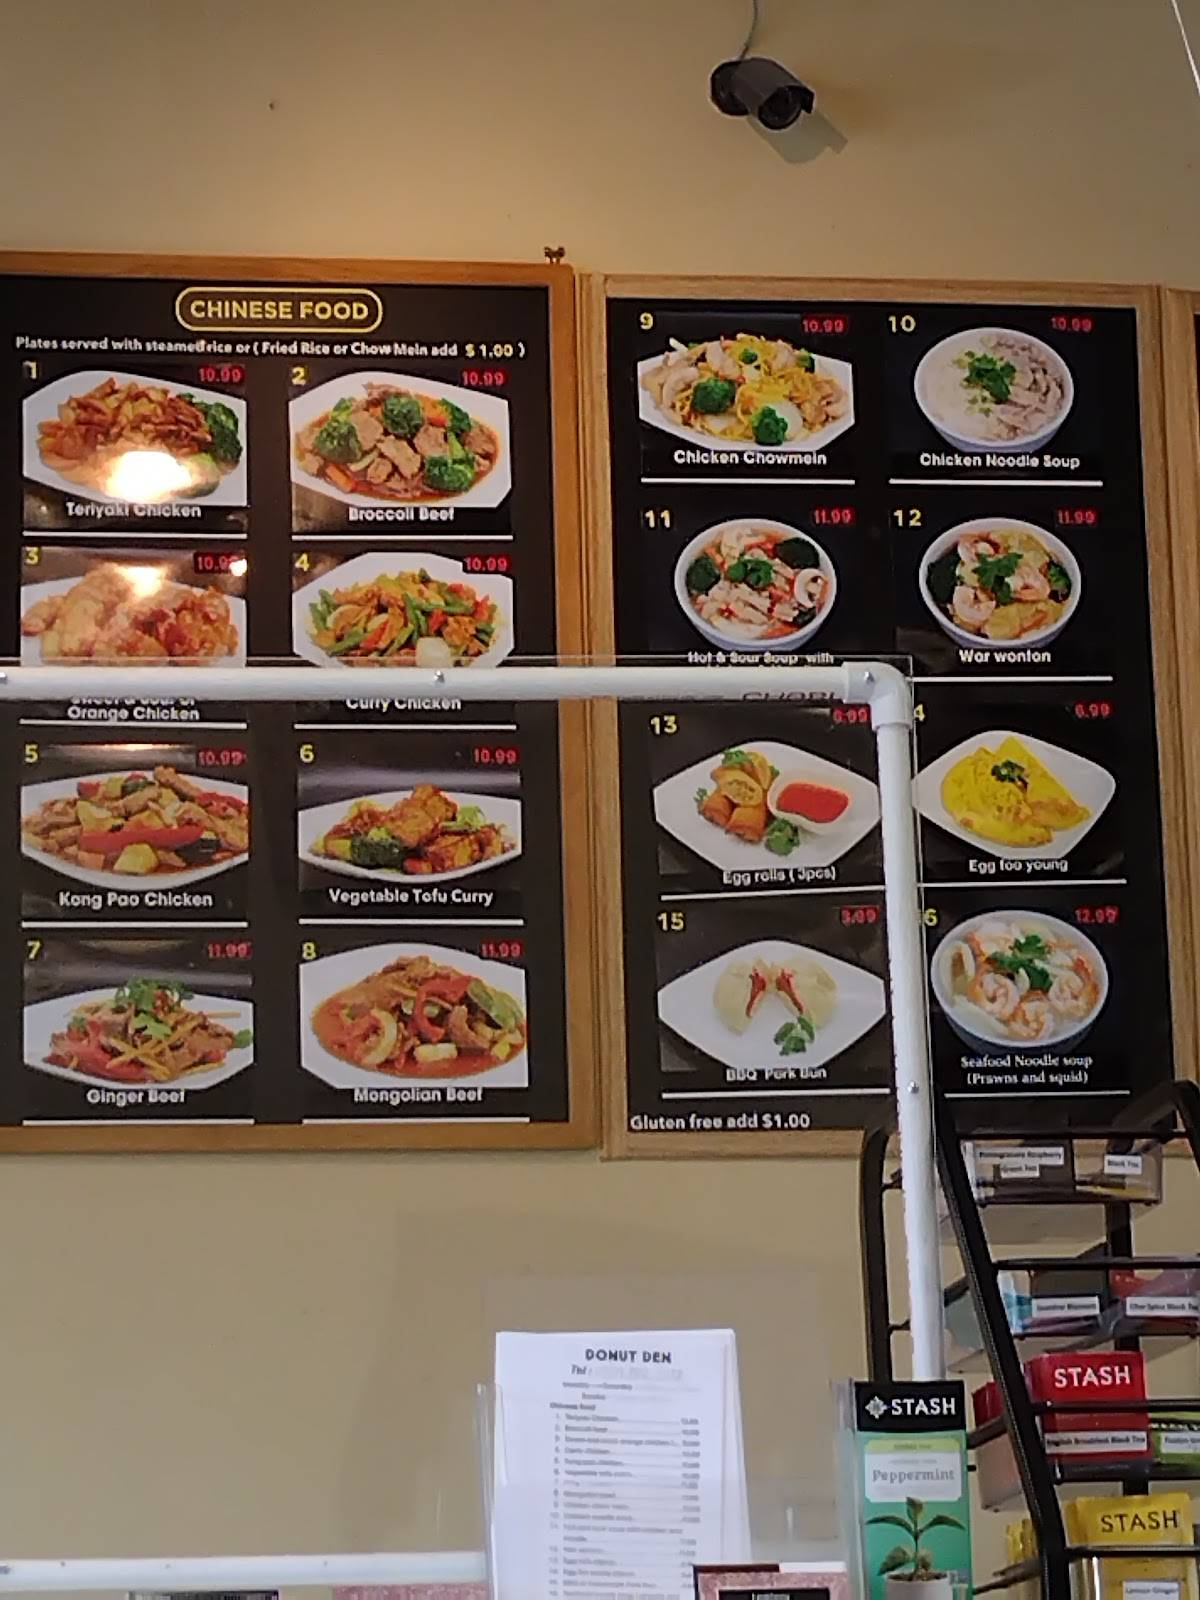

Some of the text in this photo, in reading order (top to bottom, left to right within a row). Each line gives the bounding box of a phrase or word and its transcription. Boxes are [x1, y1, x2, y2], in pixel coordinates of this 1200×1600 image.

[190, 300, 369, 320] CHINESE FOOD
[640, 312, 654, 330] 9
[803, 318, 844, 333] 10.99
[888, 315, 917, 333] 10
[1051, 317, 1092, 332] 10.99
[16, 336, 59, 350] Plates
[60, 337, 108, 350] served
[112, 338, 142, 351] with
[236, 344, 250, 354] or
[262, 341, 298, 355] Fried
[301, 342, 329, 355] Rice
[333, 345, 348, 356] or
[350, 342, 392, 356] Chow
[393, 342, 428, 356] Mein
[431, 343, 458, 357] add
[200, 367, 242, 382] 10.99
[291, 367, 306, 385] 2
[462, 371, 505, 386] 10.99
[673, 450, 827, 465] Chicken Chowmein
[919, 452, 1081, 470] Chicken Noodle Soup
[66, 501, 202, 519] Teriyaki Chicken
[348, 507, 456, 521] Broccoli Beef
[645, 509, 671, 528] 11
[814, 509, 851, 524] 11.99
[893, 509, 923, 526] 12
[1058, 510, 1096, 524] 11.99
[25, 546, 39, 565] 3
[197, 555, 246, 571] 10.9
[295, 553, 309, 572] 4
[464, 556, 508, 571] 10.99
[729, 651, 760, 664] Sour
[763, 651, 799, 665] Soup
[805, 651, 835, 664] with
[959, 649, 1052, 663] War wonton
[394, 698, 462, 710] Chicken
[67, 706, 200, 722] Orange Chicken
[650, 714, 678, 735] 13
[25, 745, 38, 763] 5
[200, 752, 242, 766] 10.99
[300, 745, 314, 763] 6
[474, 749, 517, 764] 10.99
[968, 859, 996, 874] Egg
[1026, 860, 1068, 873] young
[723, 869, 751, 886] Egg
[754, 868, 786, 883] rolls
[59, 891, 213, 910] Kong Pao Chicken
[328, 888, 494, 907] Vegetable Tofu Curry
[657, 912, 684, 932] 15
[27, 941, 41, 959] 7
[208, 943, 248, 958] 11.99
[302, 942, 316, 960] 8
[482, 943, 521, 958] 11.99
[961, 1054, 1093, 1070] Seafood Noodle soup
[726, 1068, 758, 1082] BBQ
[966, 1070, 1089, 1086] (Prawns and squid)
[86, 1088, 185, 1107] Ginger Beef
[353, 1087, 483, 1106] Mongolian Beef
[630, 1112, 811, 1130] Gluten free add $1.00
[585, 1348, 672, 1364] DONUT DEN
[1054, 1365, 1131, 1389] STASH
[891, 1397, 956, 1416] STASH
[873, 1469, 955, 1484] Peppermint
[1101, 1510, 1179, 1533] STASH
